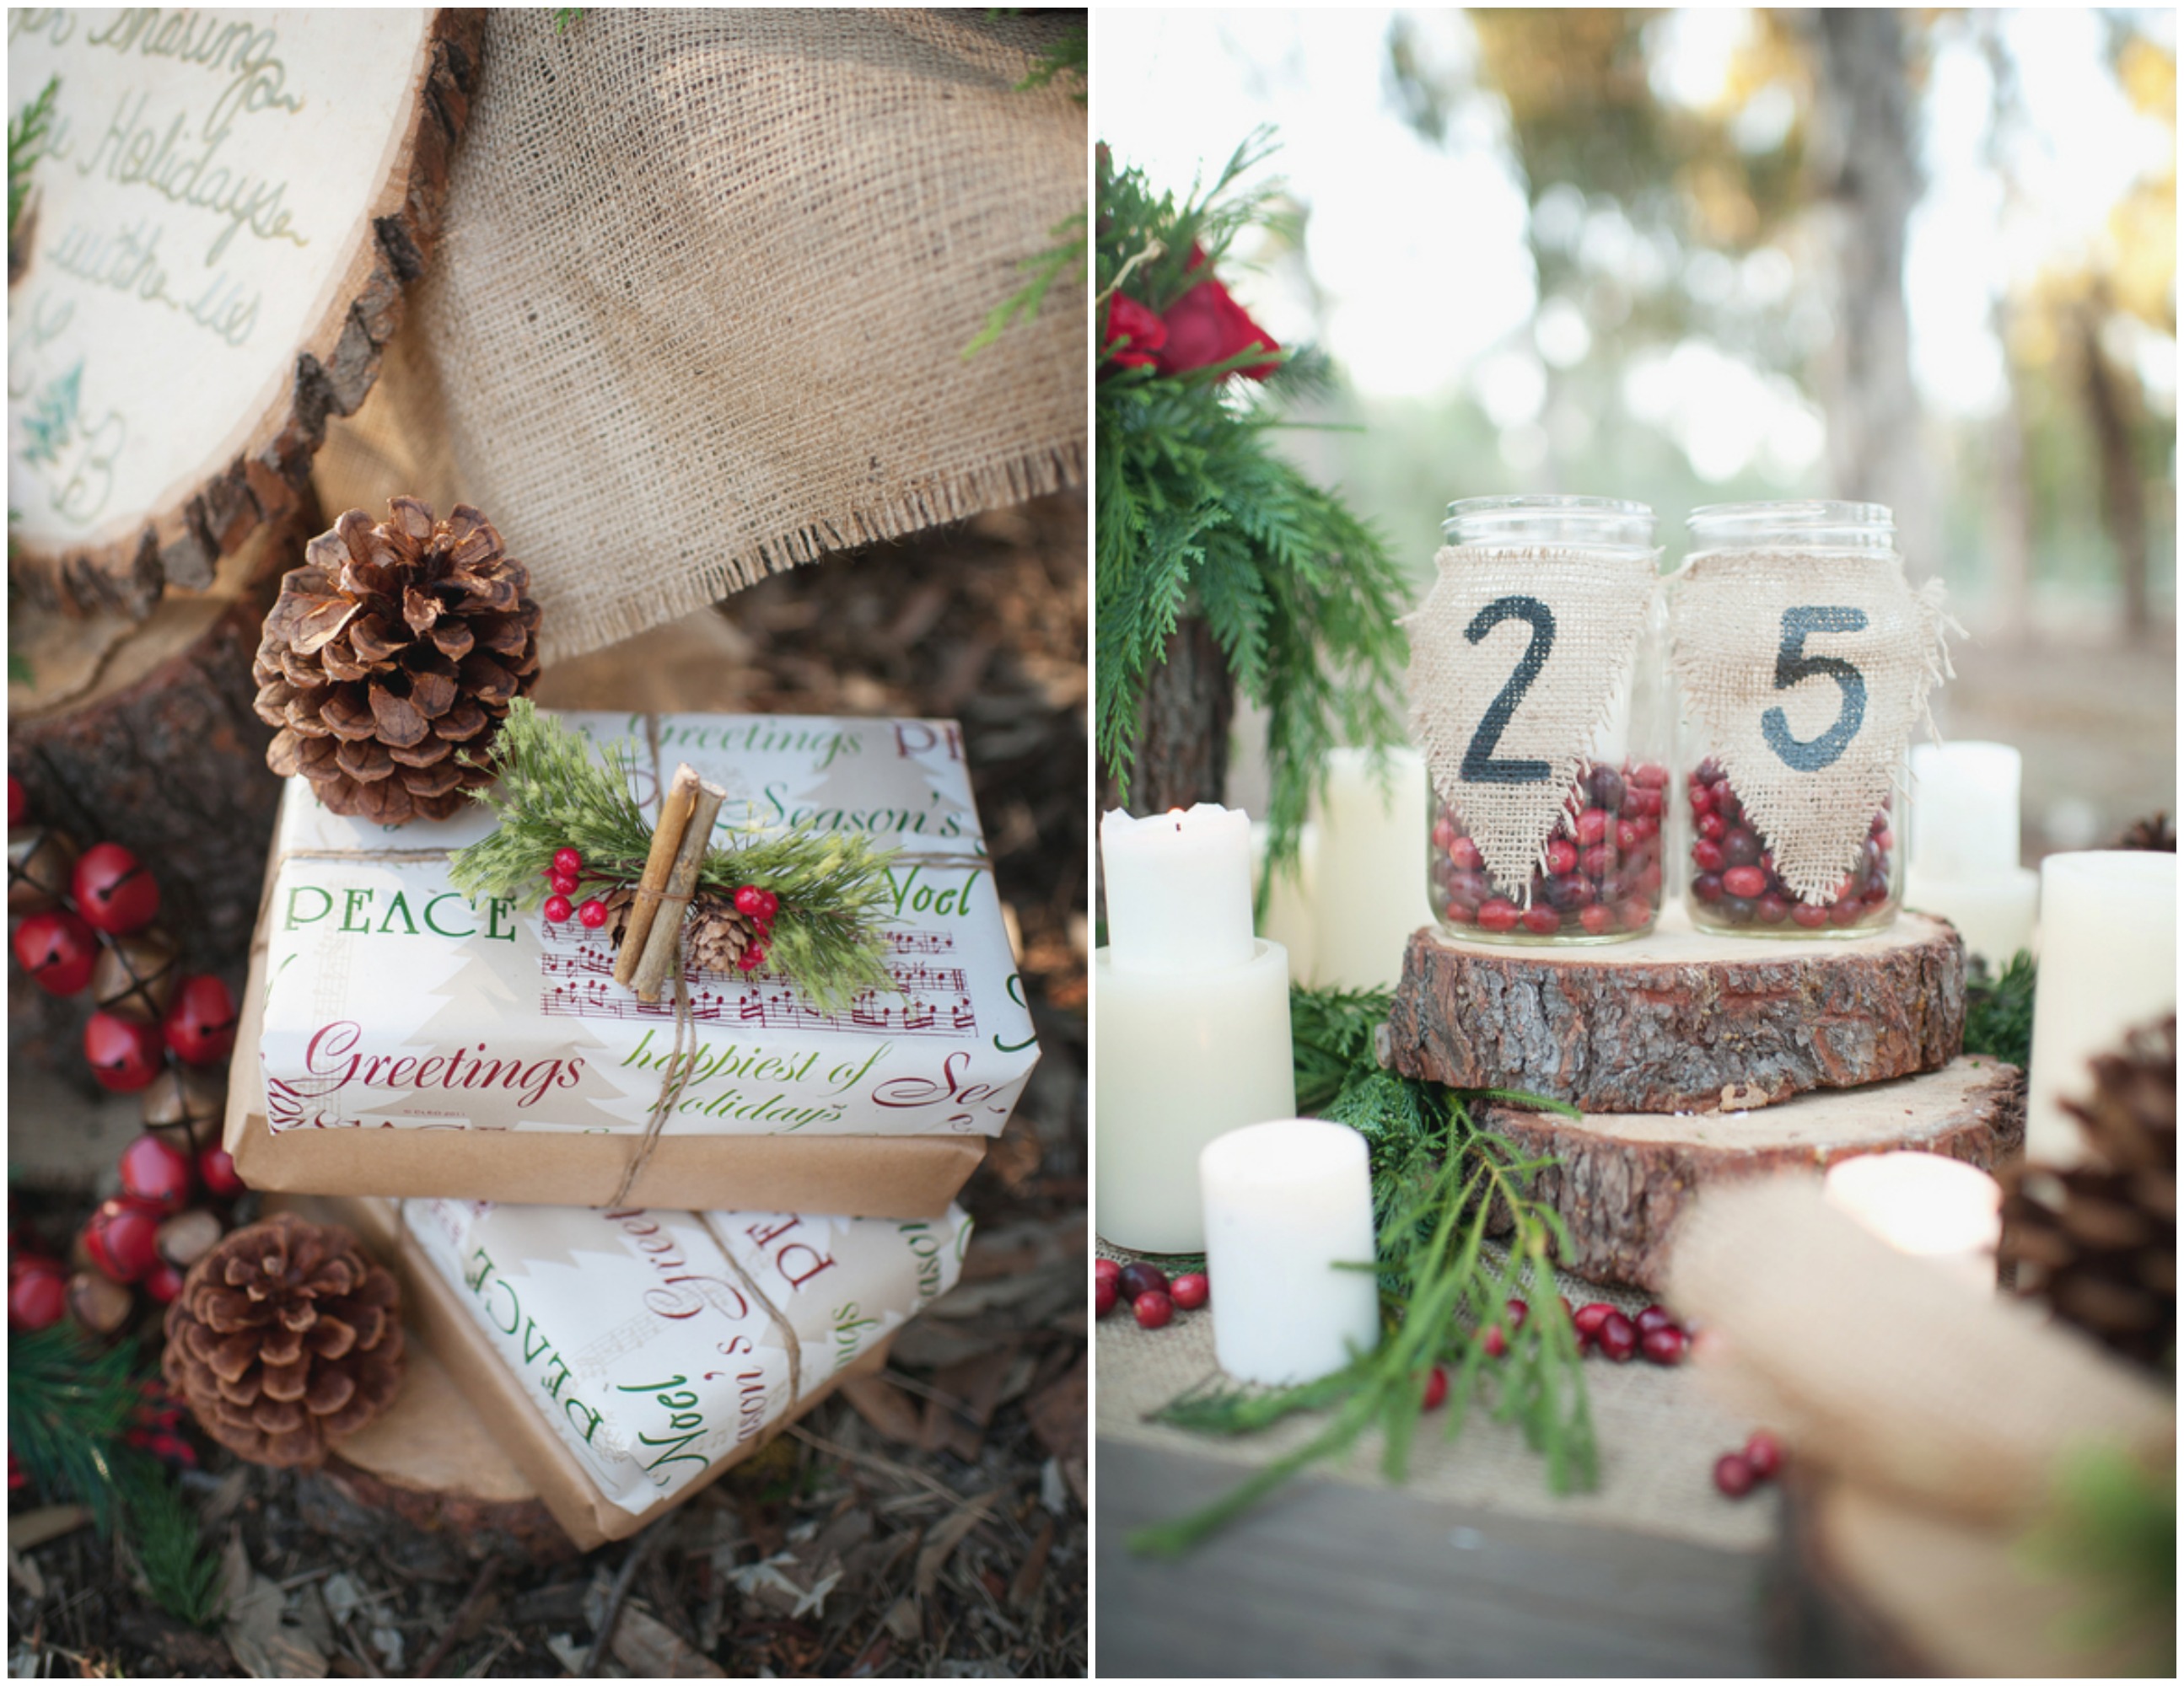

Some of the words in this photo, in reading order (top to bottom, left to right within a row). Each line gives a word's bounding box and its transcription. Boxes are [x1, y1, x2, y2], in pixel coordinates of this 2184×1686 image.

[77, 89, 309, 268] Holidays
[1460, 594, 1557, 783] 2
[1761, 604, 1869, 772] 5
[714, 781, 961, 839] Season's
[284, 884, 518, 942] PEACE
[883, 864, 982, 917] Noel
[305, 1020, 586, 1109] Greetings
[620, 1028, 821, 1087] happiest
[816, 1039, 894, 1098] of
[465, 1247, 605, 1446] PEACE
[616, 1374, 711, 1487] Noel
